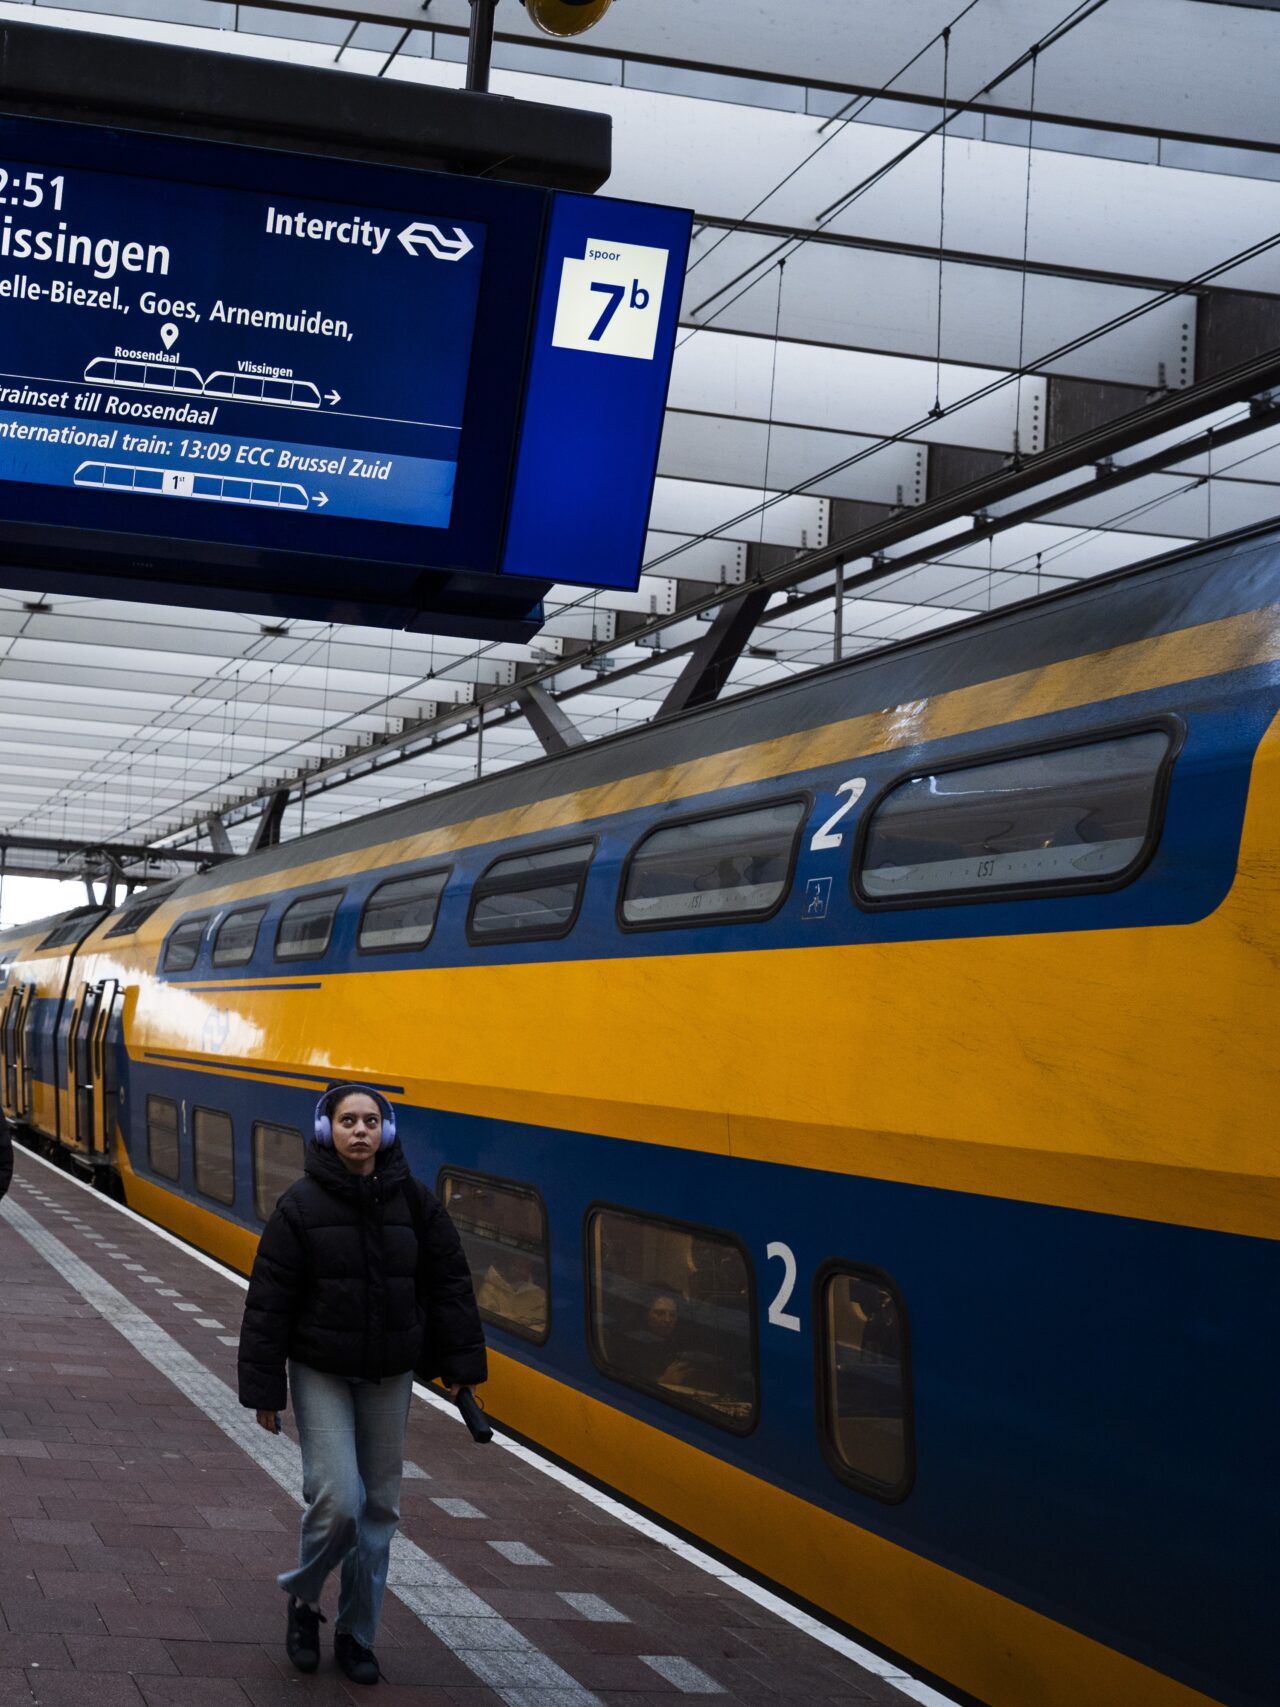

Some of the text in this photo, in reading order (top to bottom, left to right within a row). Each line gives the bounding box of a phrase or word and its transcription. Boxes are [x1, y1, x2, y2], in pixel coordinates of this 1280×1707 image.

[266, 207, 391, 254] Intercity
[588, 249, 621, 261] spoor
[139, 291, 201, 322] Goes,
[209, 300, 354, 342] Arnemuiden,
[114, 346, 180, 364] Roosendaal
[237, 360, 293, 378] Vlissingen
[74, 392, 102, 412] till
[105, 396, 218, 426] Roosendaal
[122, 433, 173, 456] train:
[180, 439, 232, 462] 13:09
[235, 445, 274, 466] ECC
[277, 450, 347, 474] Brussel
[349, 458, 393, 480] Zuid
[810, 777, 867, 851] 2
[766, 1241, 801, 1332] 2
